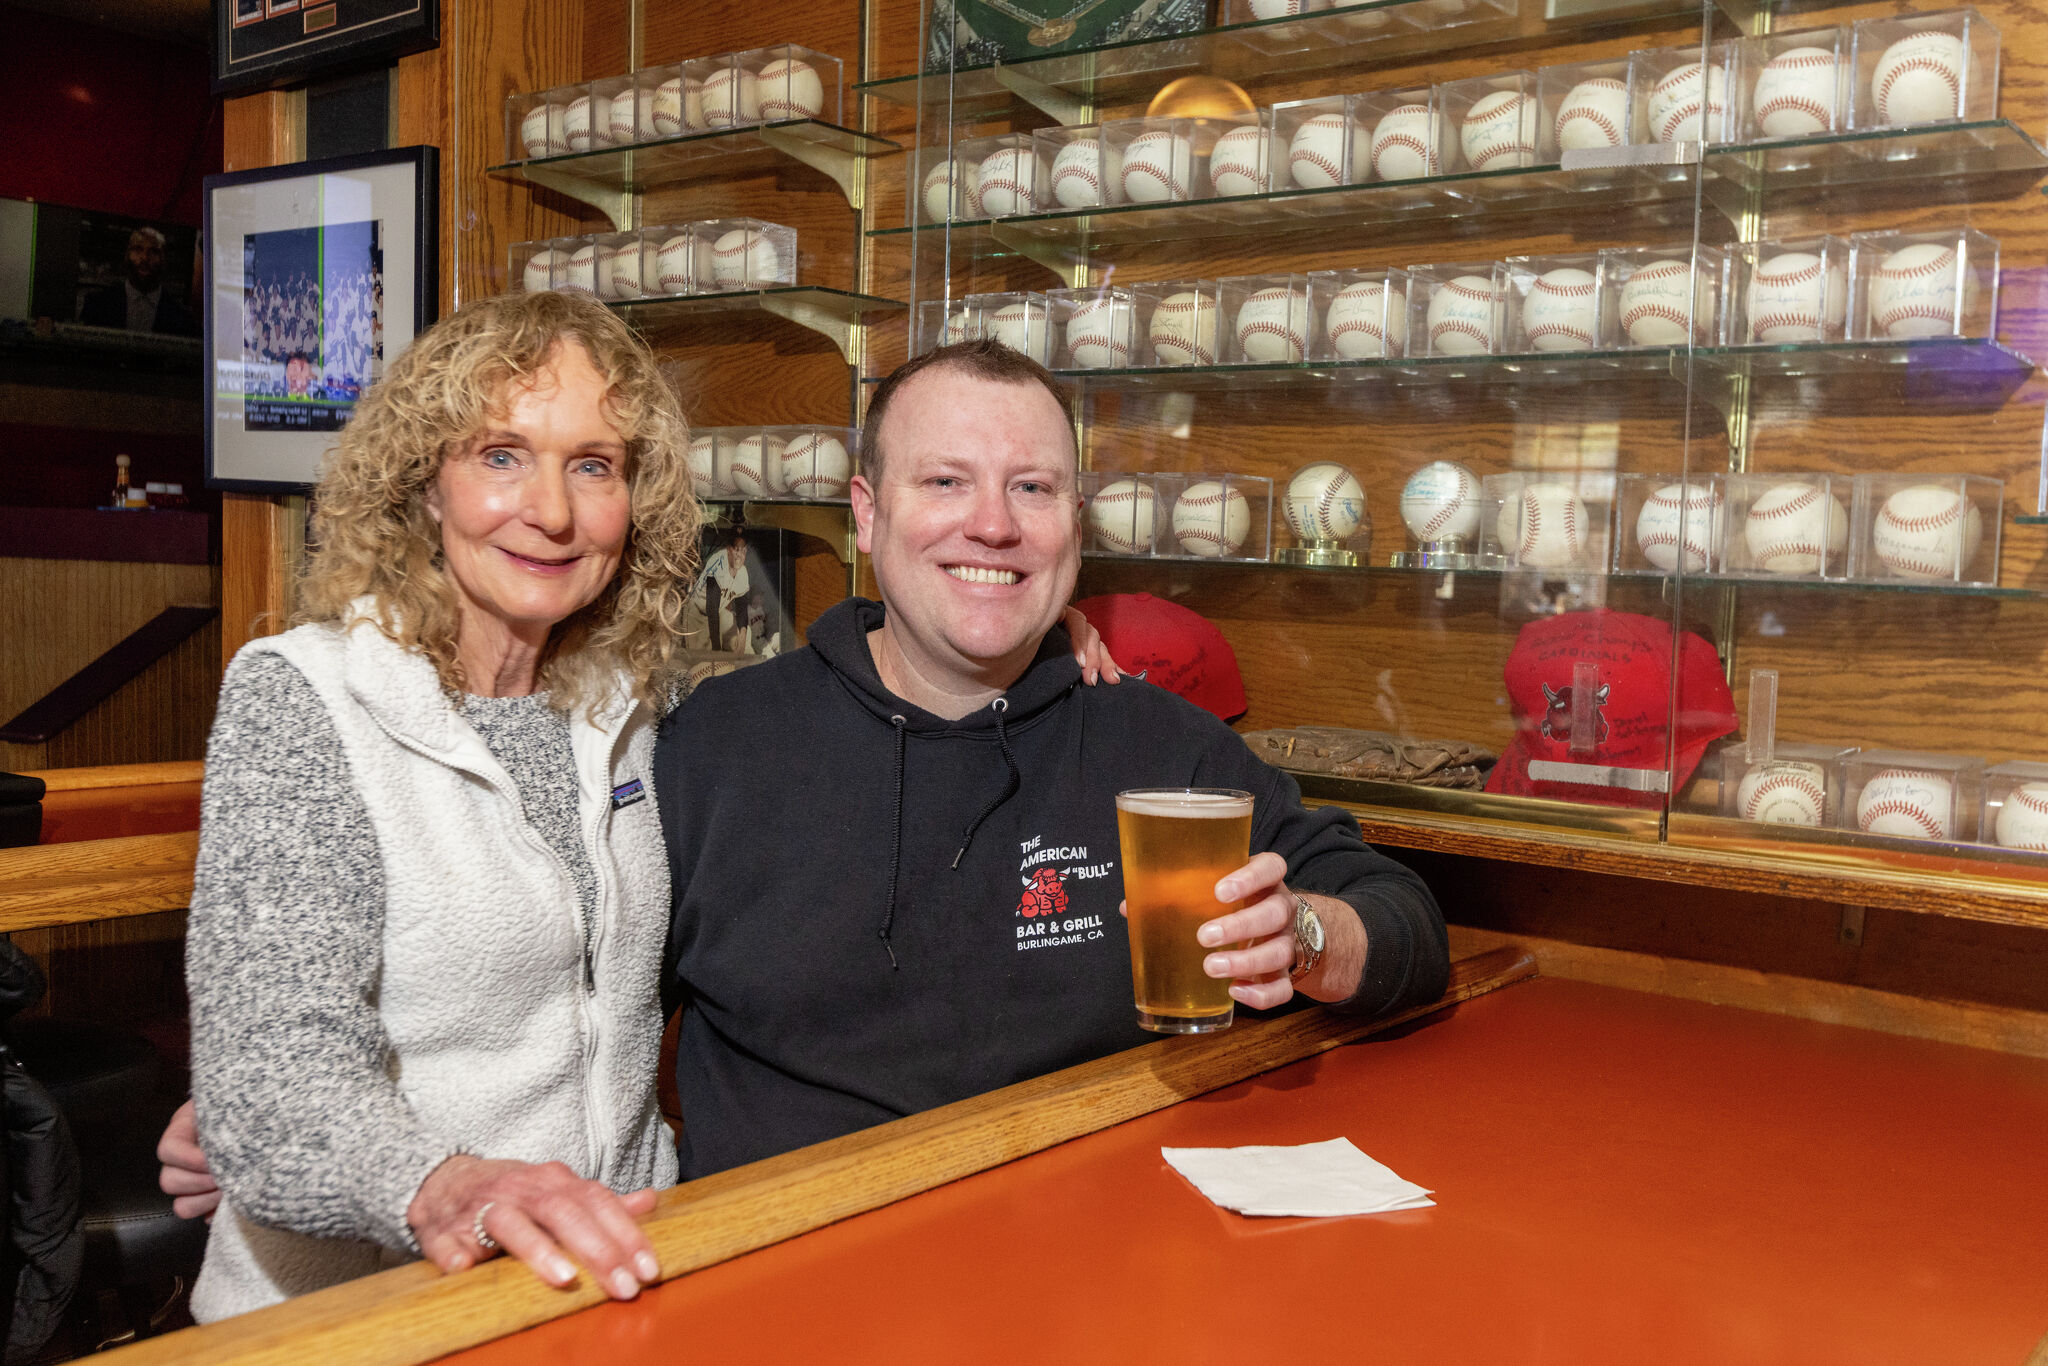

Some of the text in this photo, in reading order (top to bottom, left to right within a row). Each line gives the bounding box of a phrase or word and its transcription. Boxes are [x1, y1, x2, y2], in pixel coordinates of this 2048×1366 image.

[1020, 835, 1041, 854] THE
[1019, 846, 1088, 872] AMERICAN
[1016, 914, 1103, 939] BAR & GRILL
[1017, 929, 1104, 951] BURLINGAME, CA
